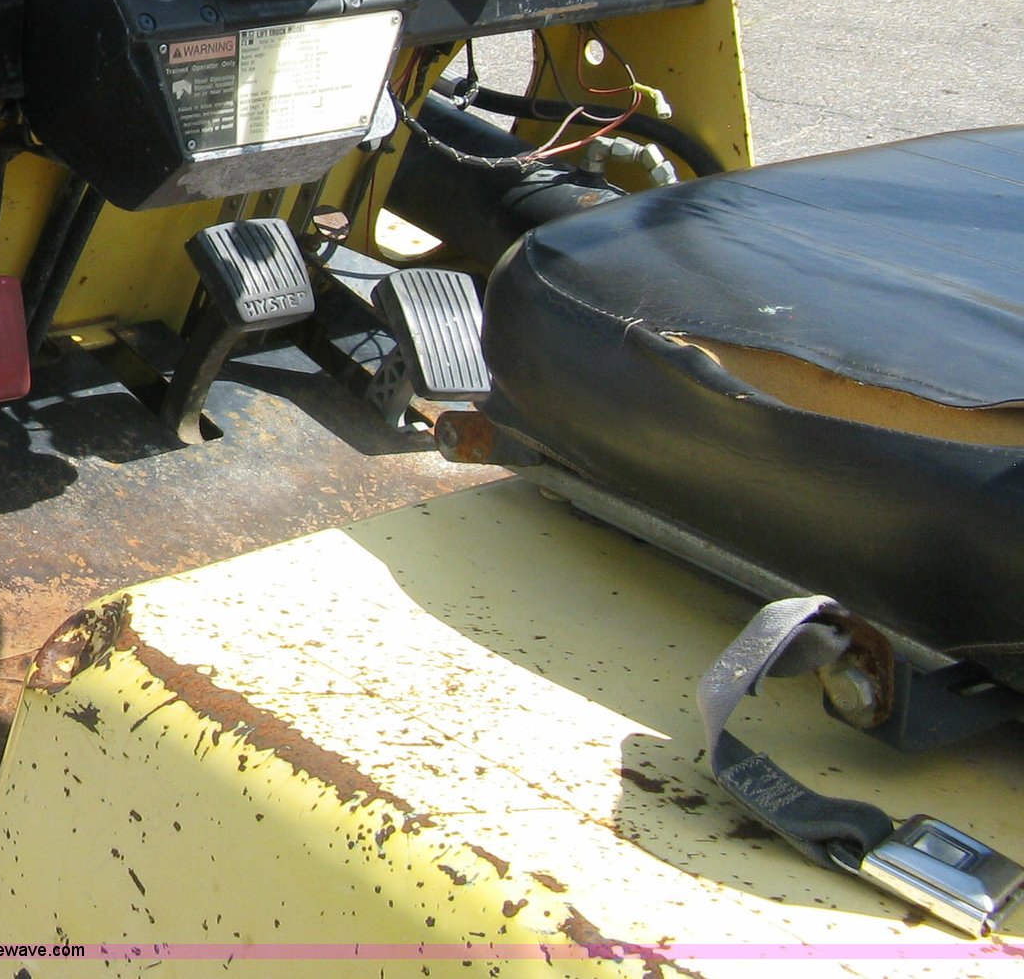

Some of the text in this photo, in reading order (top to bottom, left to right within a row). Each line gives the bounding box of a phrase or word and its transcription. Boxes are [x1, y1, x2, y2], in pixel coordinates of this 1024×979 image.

[182, 40, 234, 57] WARNING
[221, 60, 236, 69] Only
[244, 291, 307, 317] HYSTER
